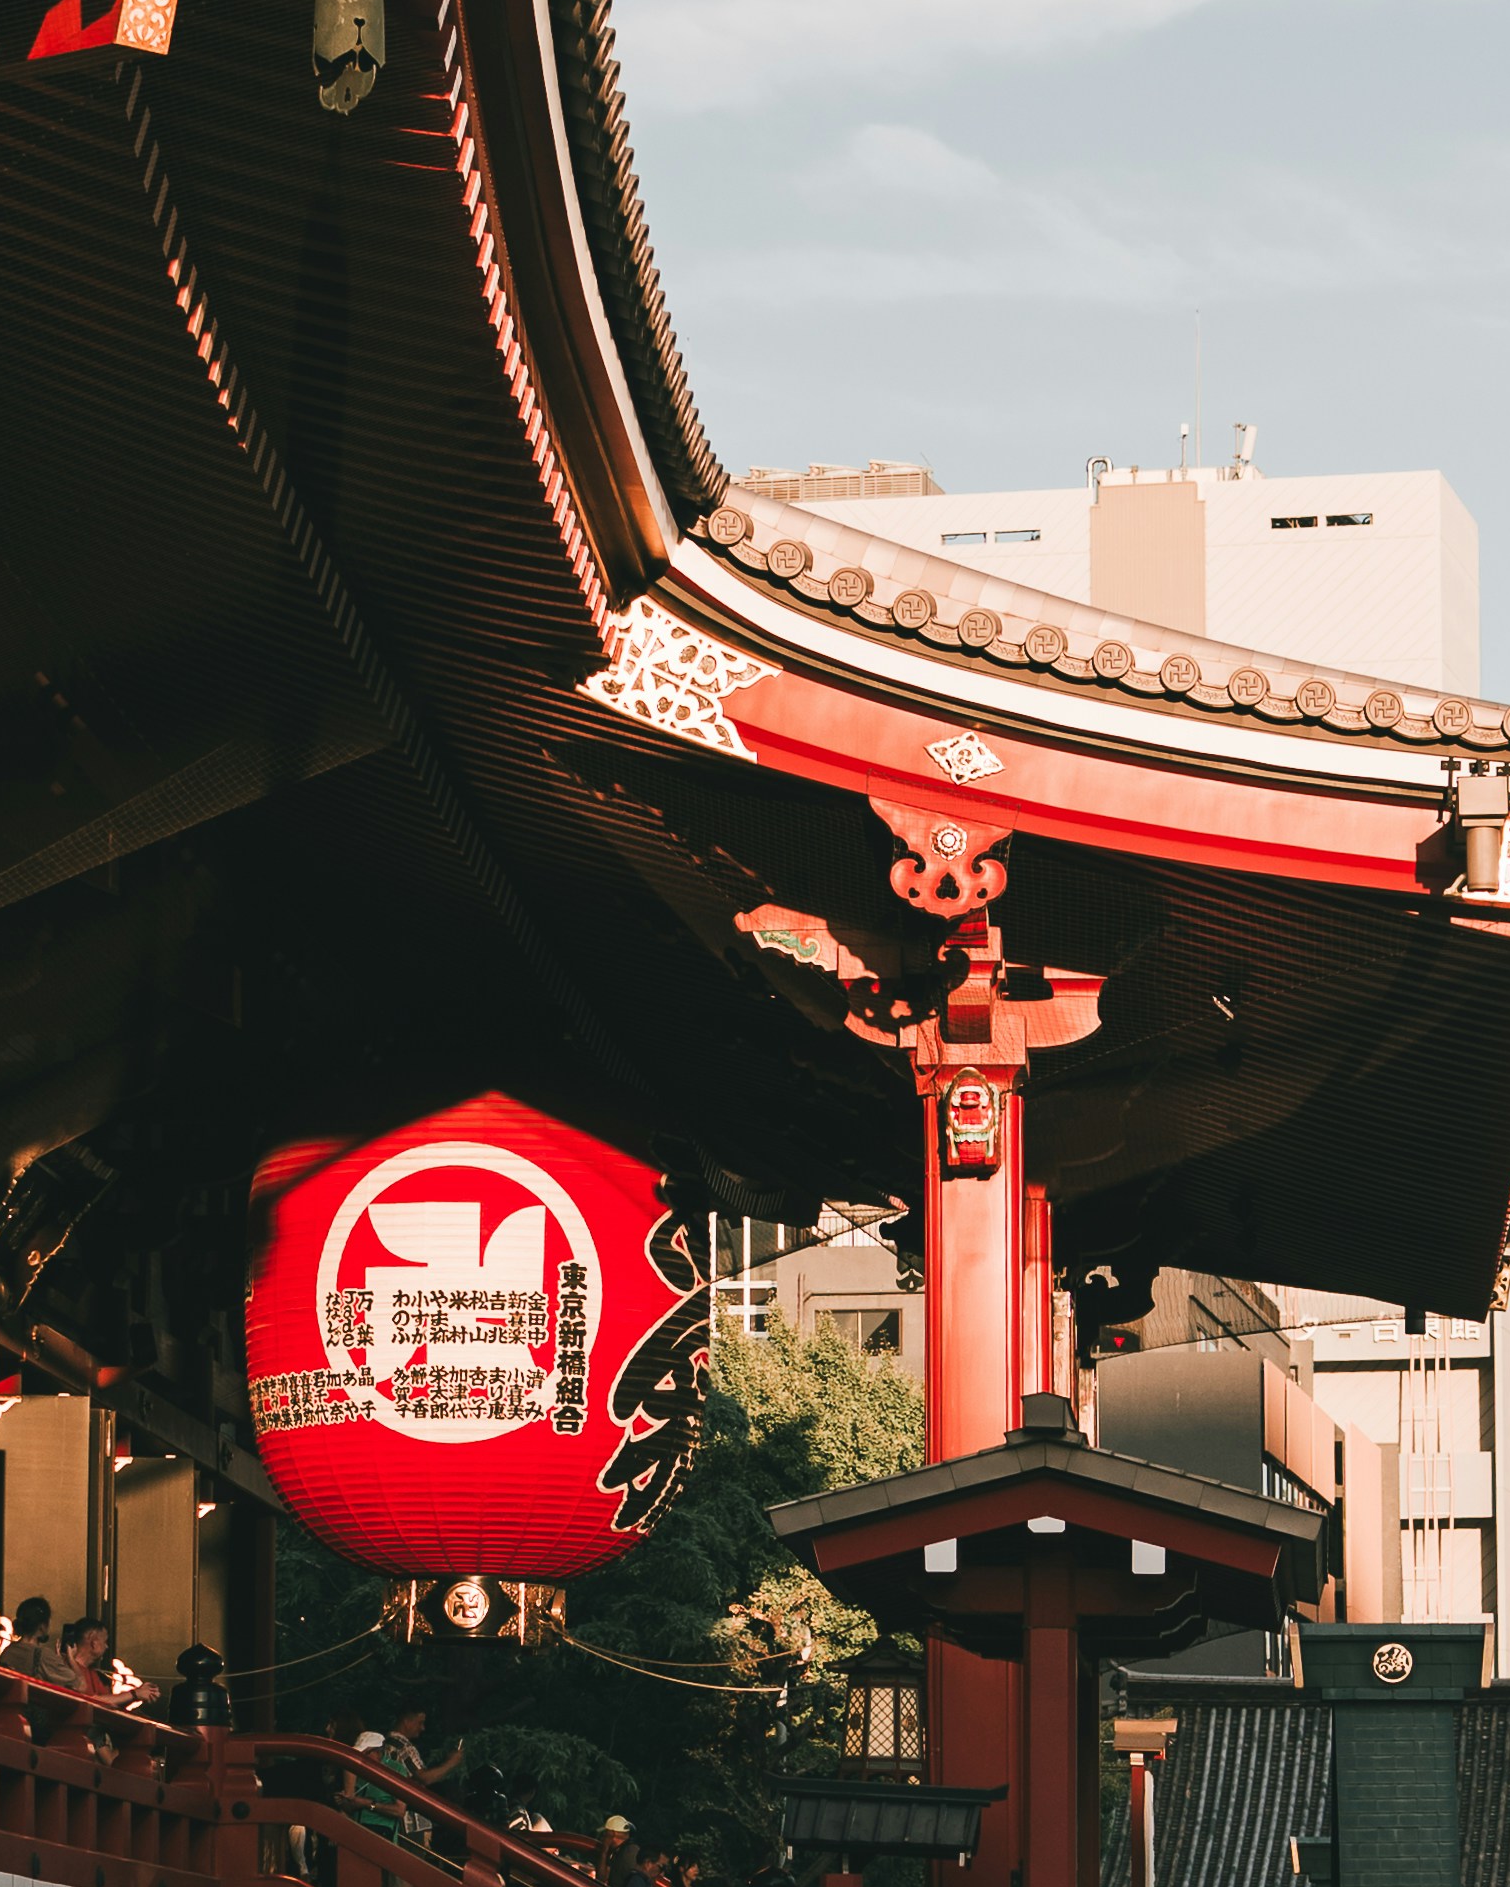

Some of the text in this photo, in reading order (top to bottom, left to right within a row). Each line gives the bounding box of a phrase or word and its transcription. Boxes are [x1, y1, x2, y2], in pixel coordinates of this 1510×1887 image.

[342, 1290, 356, 1347] Jade
[357, 1290, 374, 1347] 万葉
[449, 1290, 469, 1345] 米村
[469, 1290, 489, 1344] 松山
[528, 1291, 547, 1345] 金田中
[553, 1263, 588, 1433] 東京新橋組合
[326, 1370, 344, 1421] 加奈
[343, 1370, 359, 1419] あや
[358, 1367, 377, 1419] 晶子
[394, 1367, 411, 1419] 多賀子
[429, 1365, 449, 1419] 栄太郎
[449, 1365, 468, 1419] 加津代
[468, 1366, 488, 1419] 杏子
[487, 1367, 507, 1420] まり恵
[526, 1369, 545, 1420] 清み
